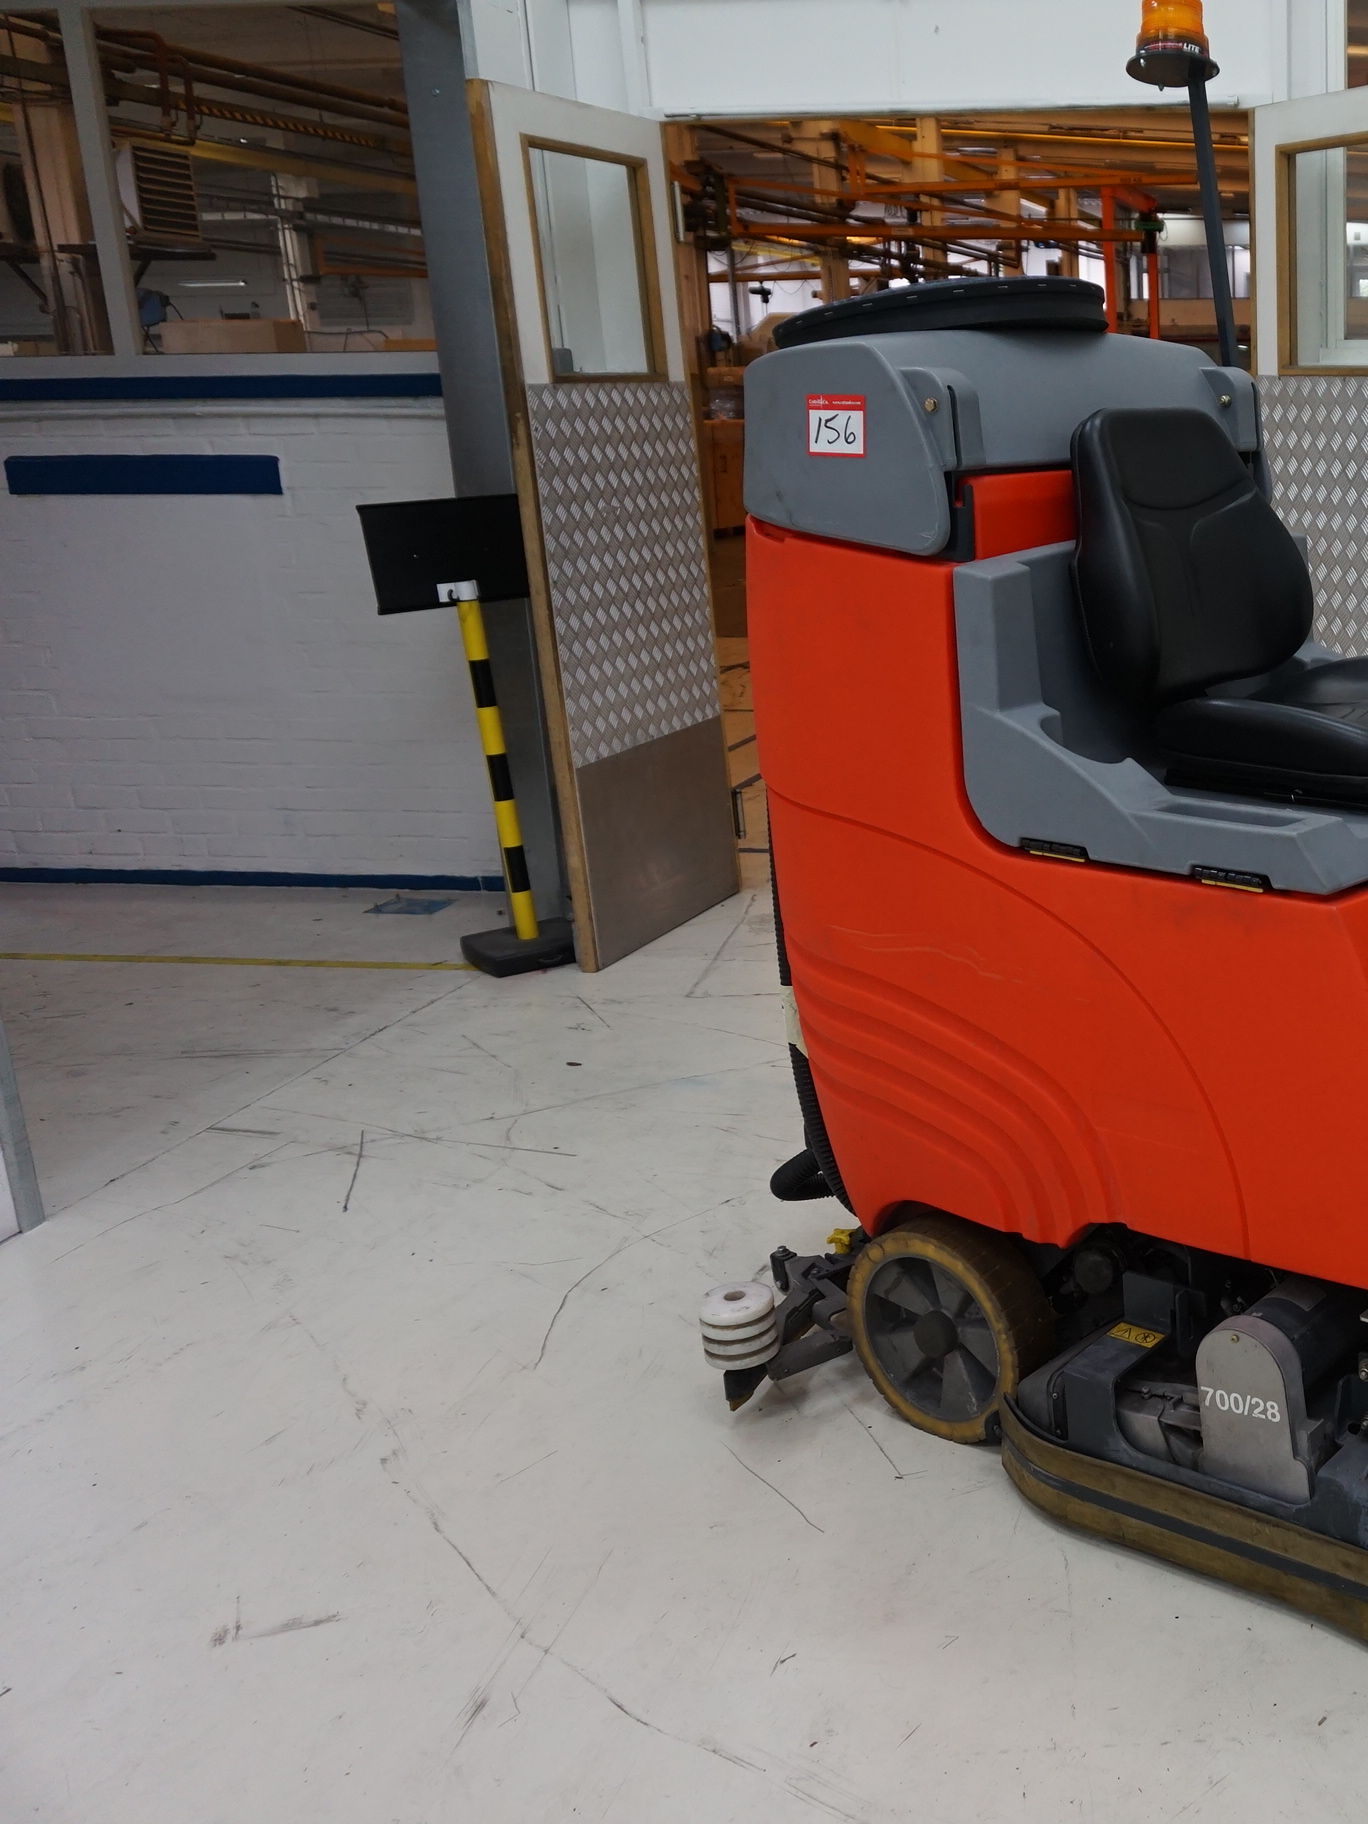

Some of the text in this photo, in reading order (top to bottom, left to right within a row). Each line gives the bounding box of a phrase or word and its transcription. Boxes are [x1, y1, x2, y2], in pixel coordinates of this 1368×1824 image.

[1183, 42, 1201, 53] LITE
[814, 413, 857, 445] 156
[1200, 1386, 1281, 1423] 700/28
